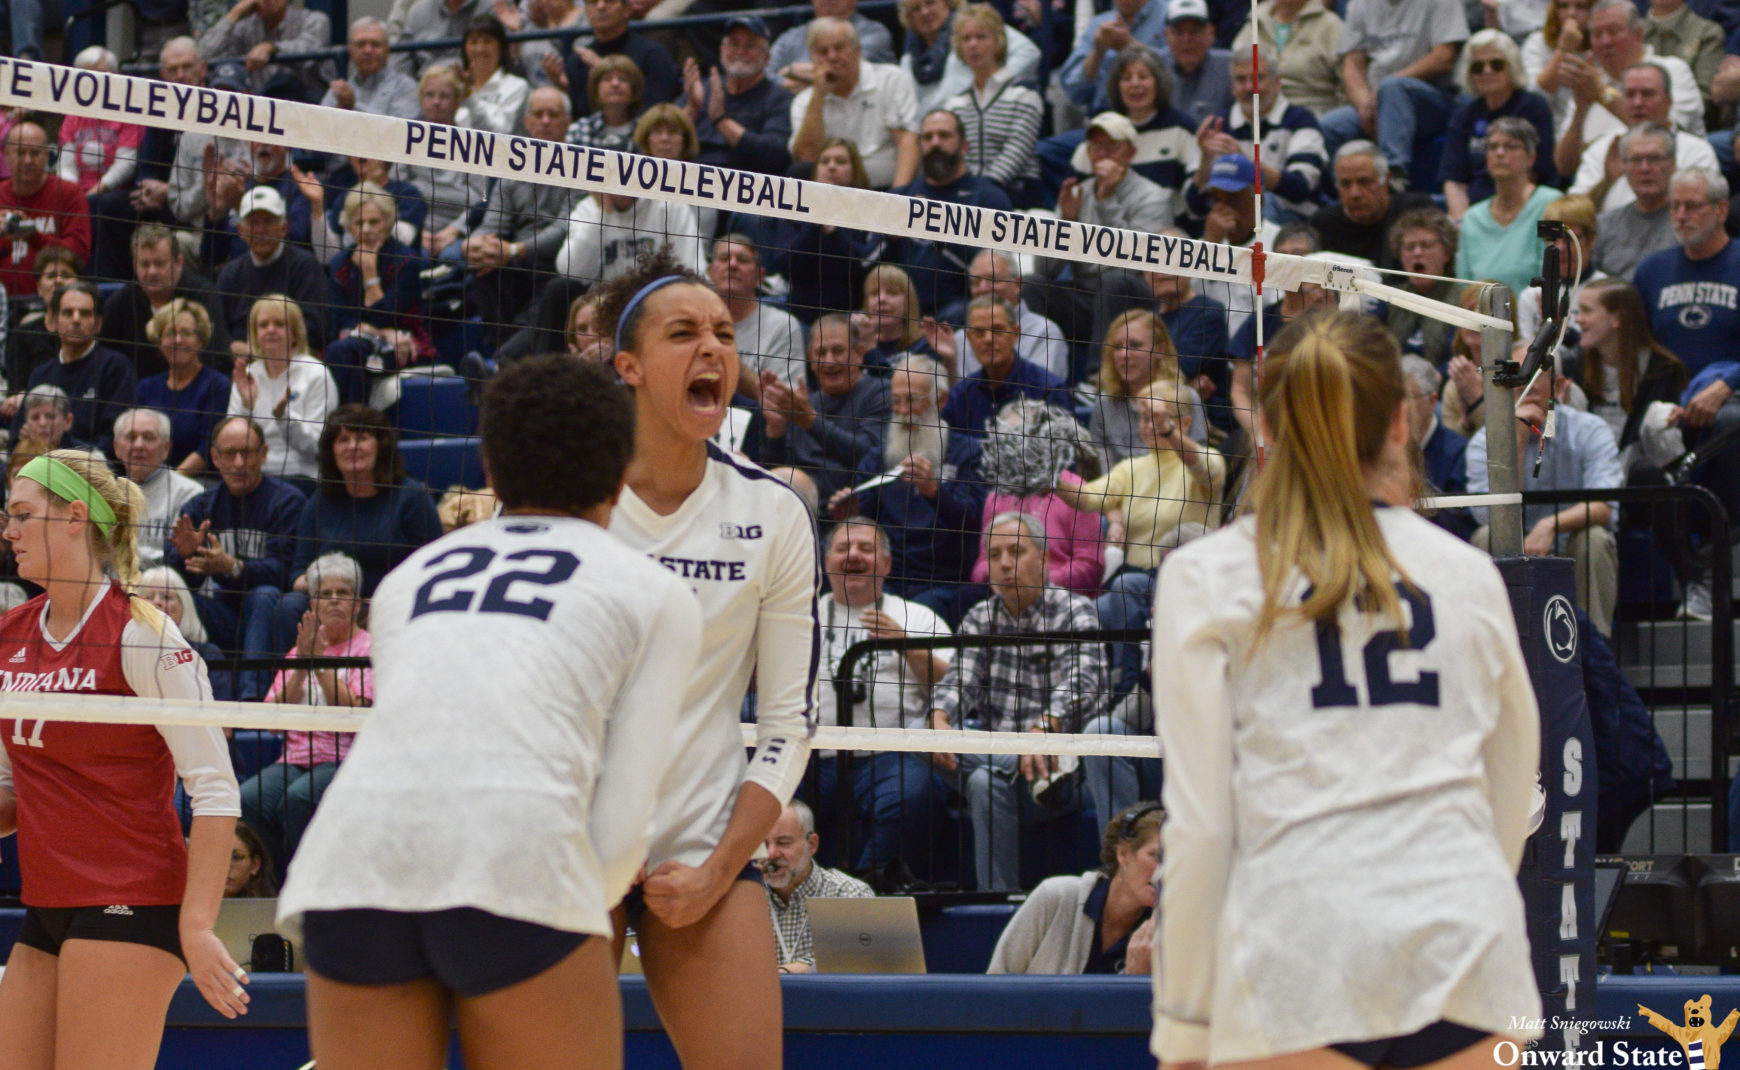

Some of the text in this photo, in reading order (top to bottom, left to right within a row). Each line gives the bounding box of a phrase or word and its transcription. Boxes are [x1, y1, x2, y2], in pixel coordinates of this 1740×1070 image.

[48, 66, 285, 136] VOLLEYBALL
[405, 121, 810, 214] PENN STATE VOLLEYBALL
[907, 198, 1237, 275] PENN STATE VOLLEYBALL
[1658, 281, 1738, 310] PENN STATE
[408, 547, 581, 622] 22
[0, 667, 96, 692] NDIANA
[1301, 576, 1439, 709] 12
